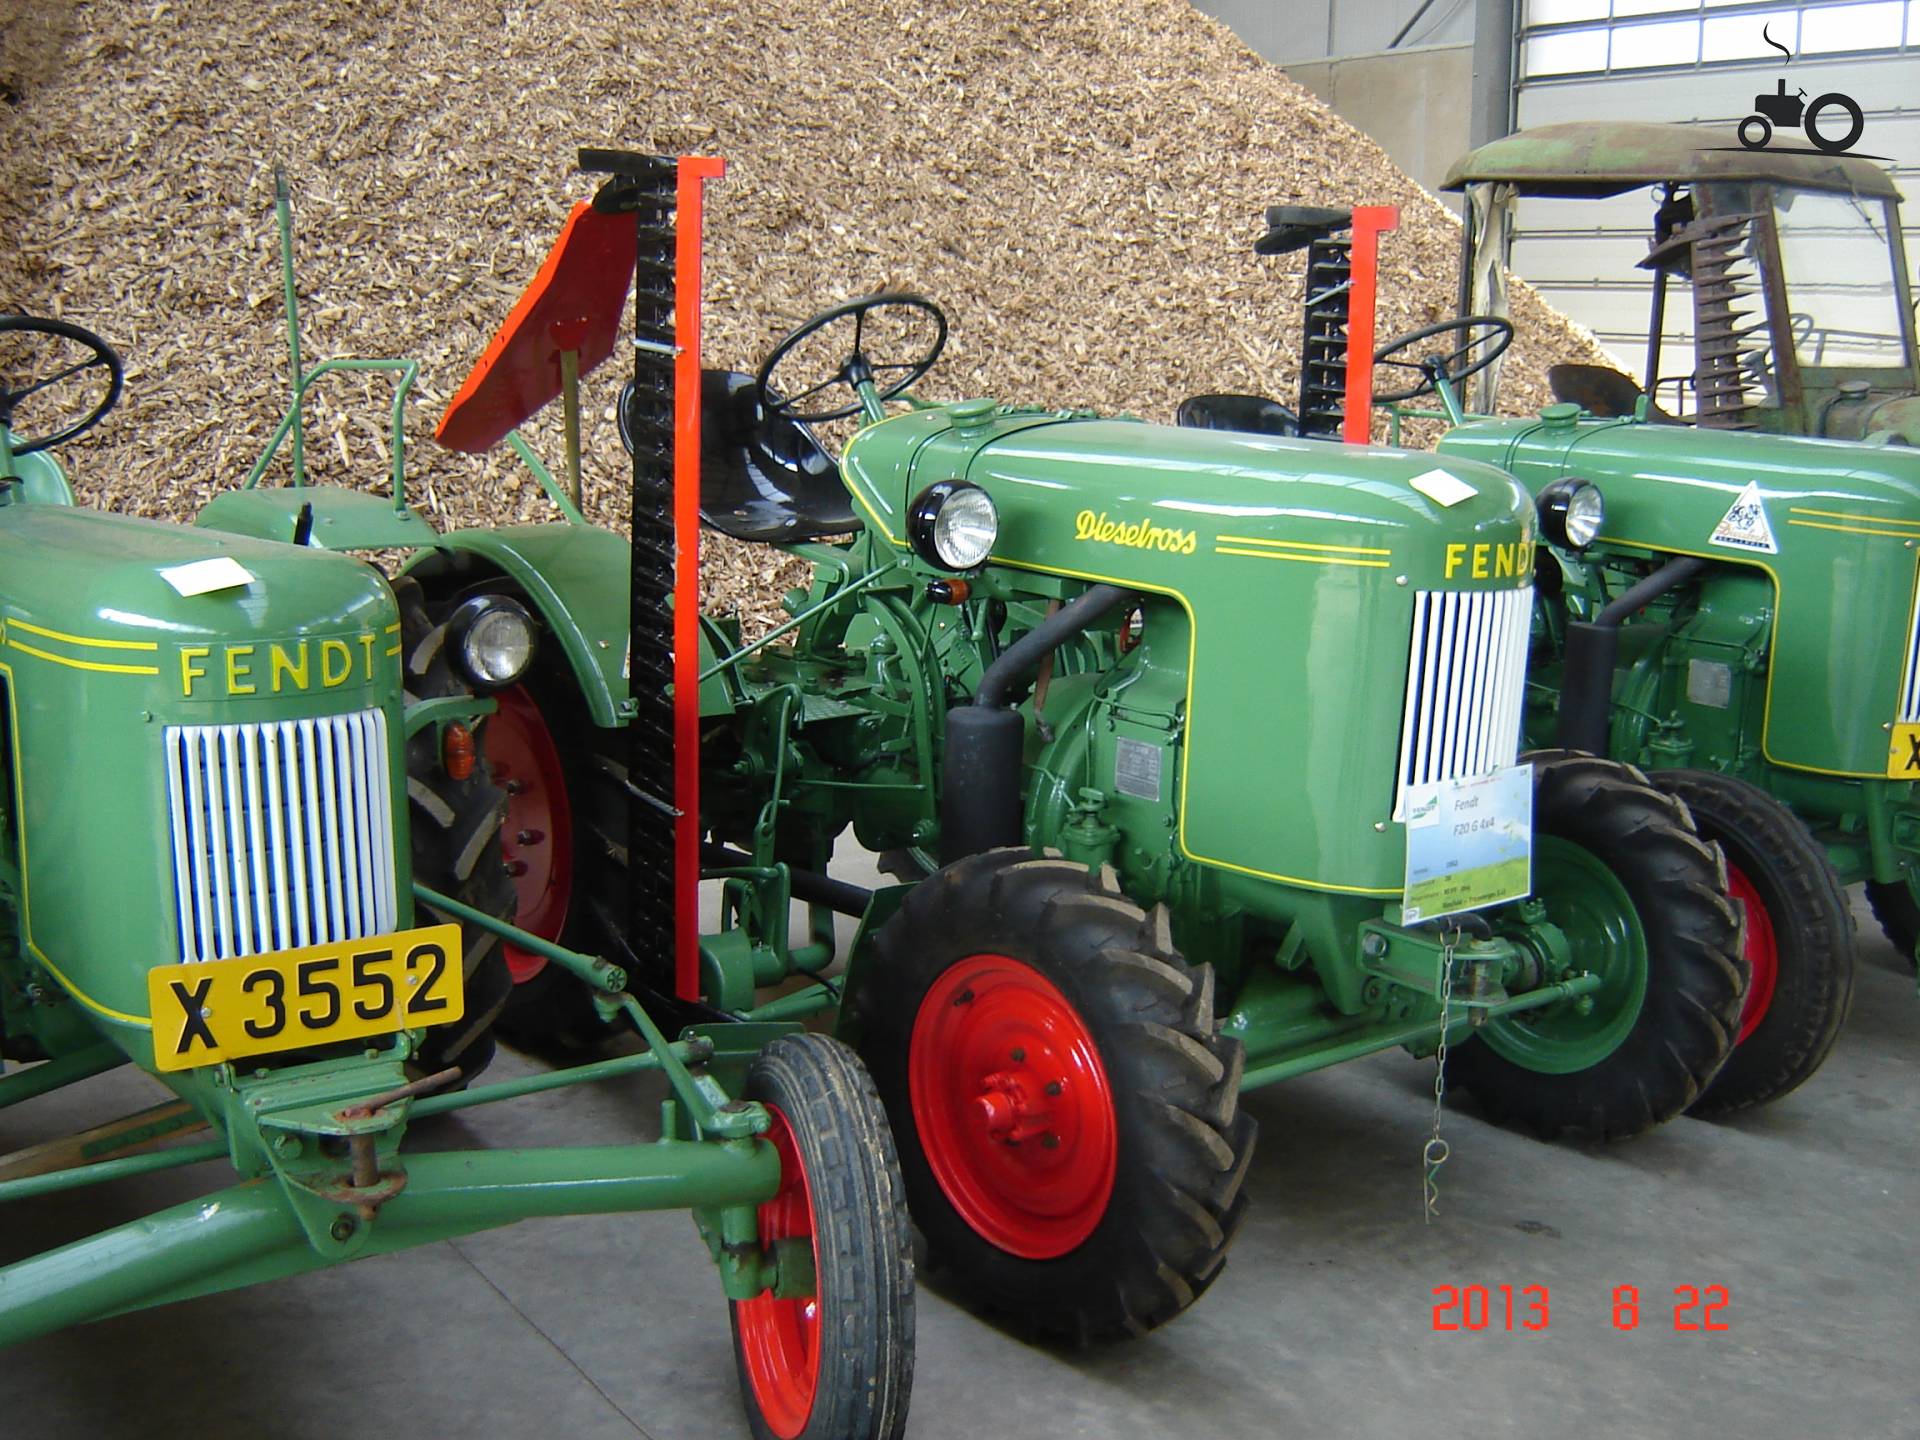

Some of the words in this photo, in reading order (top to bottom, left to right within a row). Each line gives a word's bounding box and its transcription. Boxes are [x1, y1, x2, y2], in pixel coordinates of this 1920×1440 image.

[1076, 509, 1197, 555] Dieselross
[180, 634, 377, 696] FENDT
[1454, 795, 1479, 811] Fendt
[1479, 816, 1495, 831] 4x4
[169, 977, 219, 1054] X
[242, 944, 448, 1039] 3552
